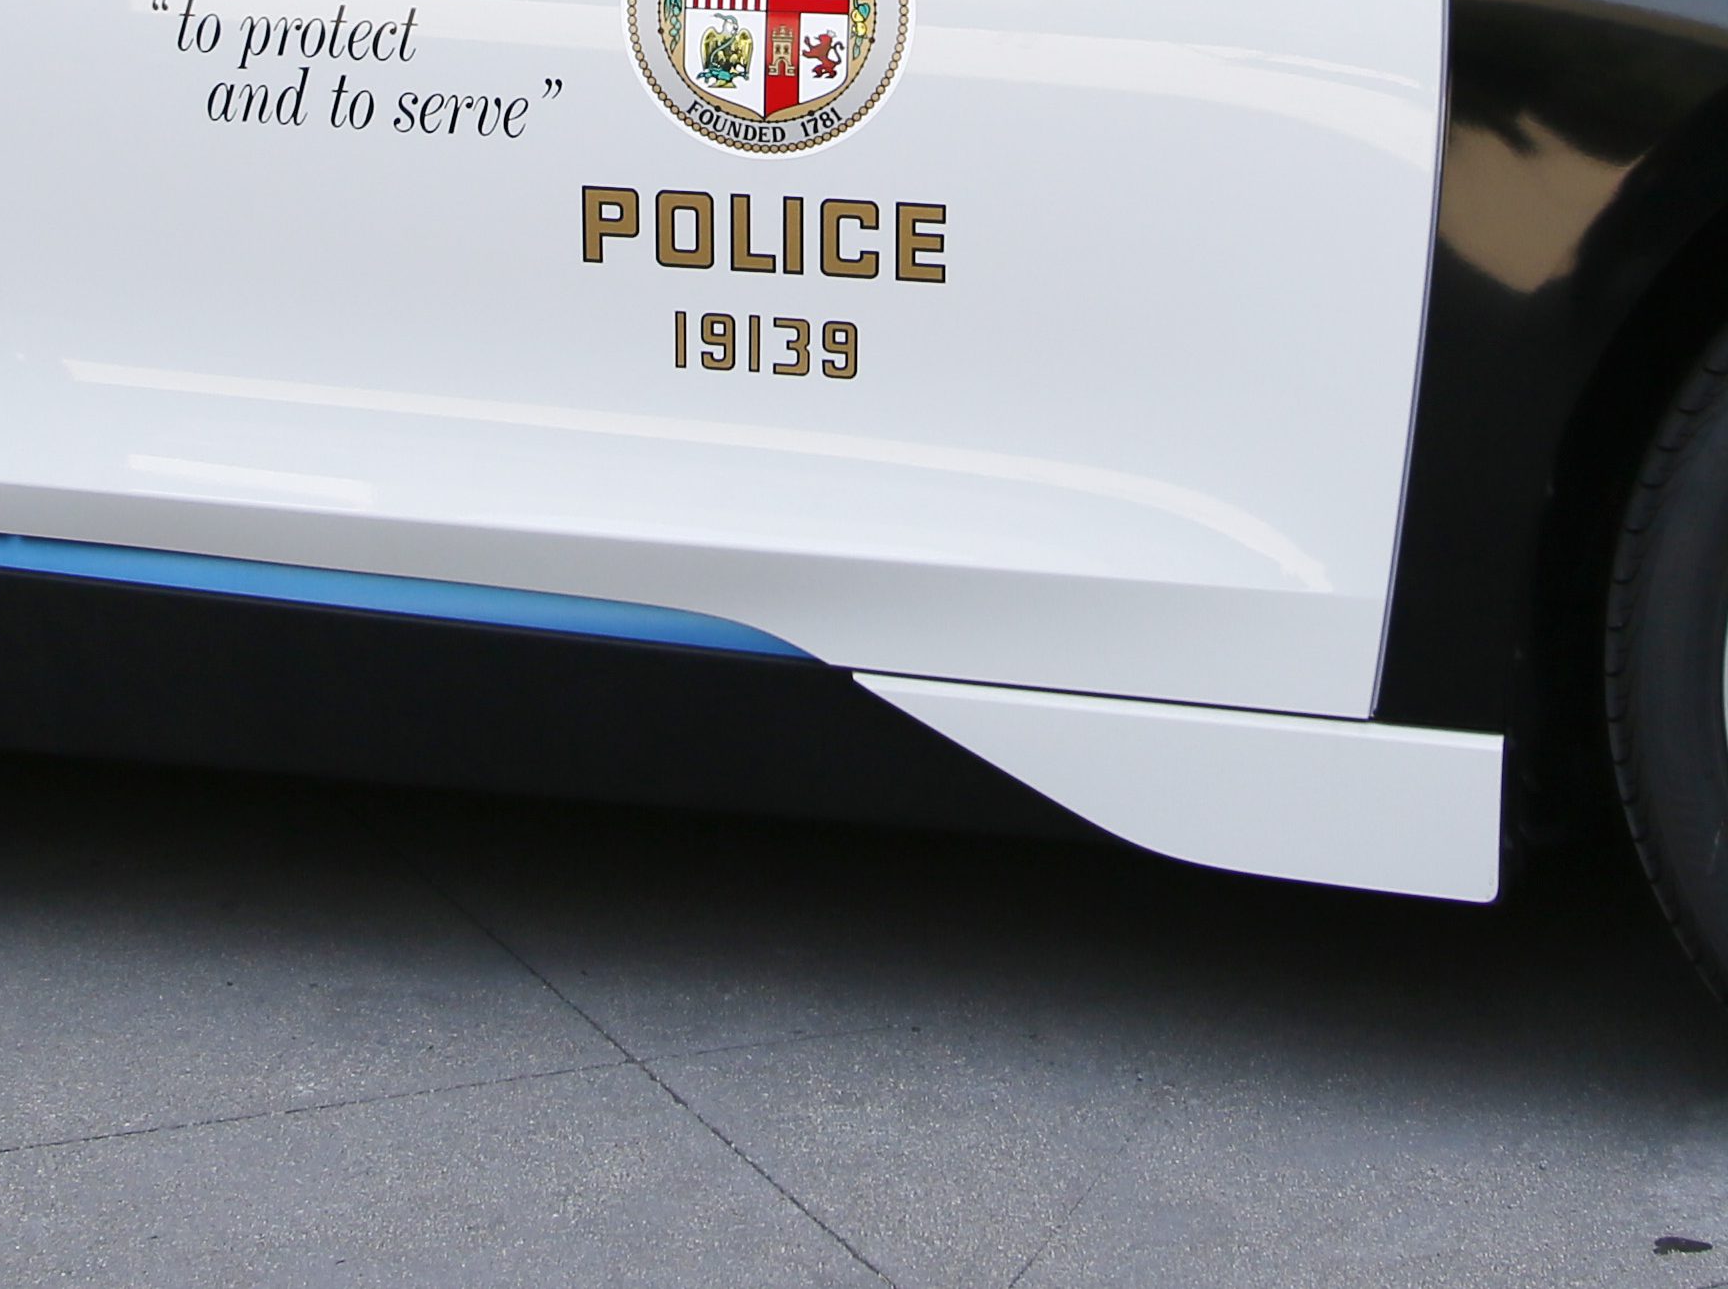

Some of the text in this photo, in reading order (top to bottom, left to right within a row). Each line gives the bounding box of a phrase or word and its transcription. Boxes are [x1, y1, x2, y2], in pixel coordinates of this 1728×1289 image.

[236, 4, 419, 70] protect
[206, 66, 311, 127] and
[329, 74, 376, 130] to
[686, 100, 844, 144] FOUNDED 1781
[581, 185, 947, 284] POLICE
[674, 310, 859, 380] 19139
